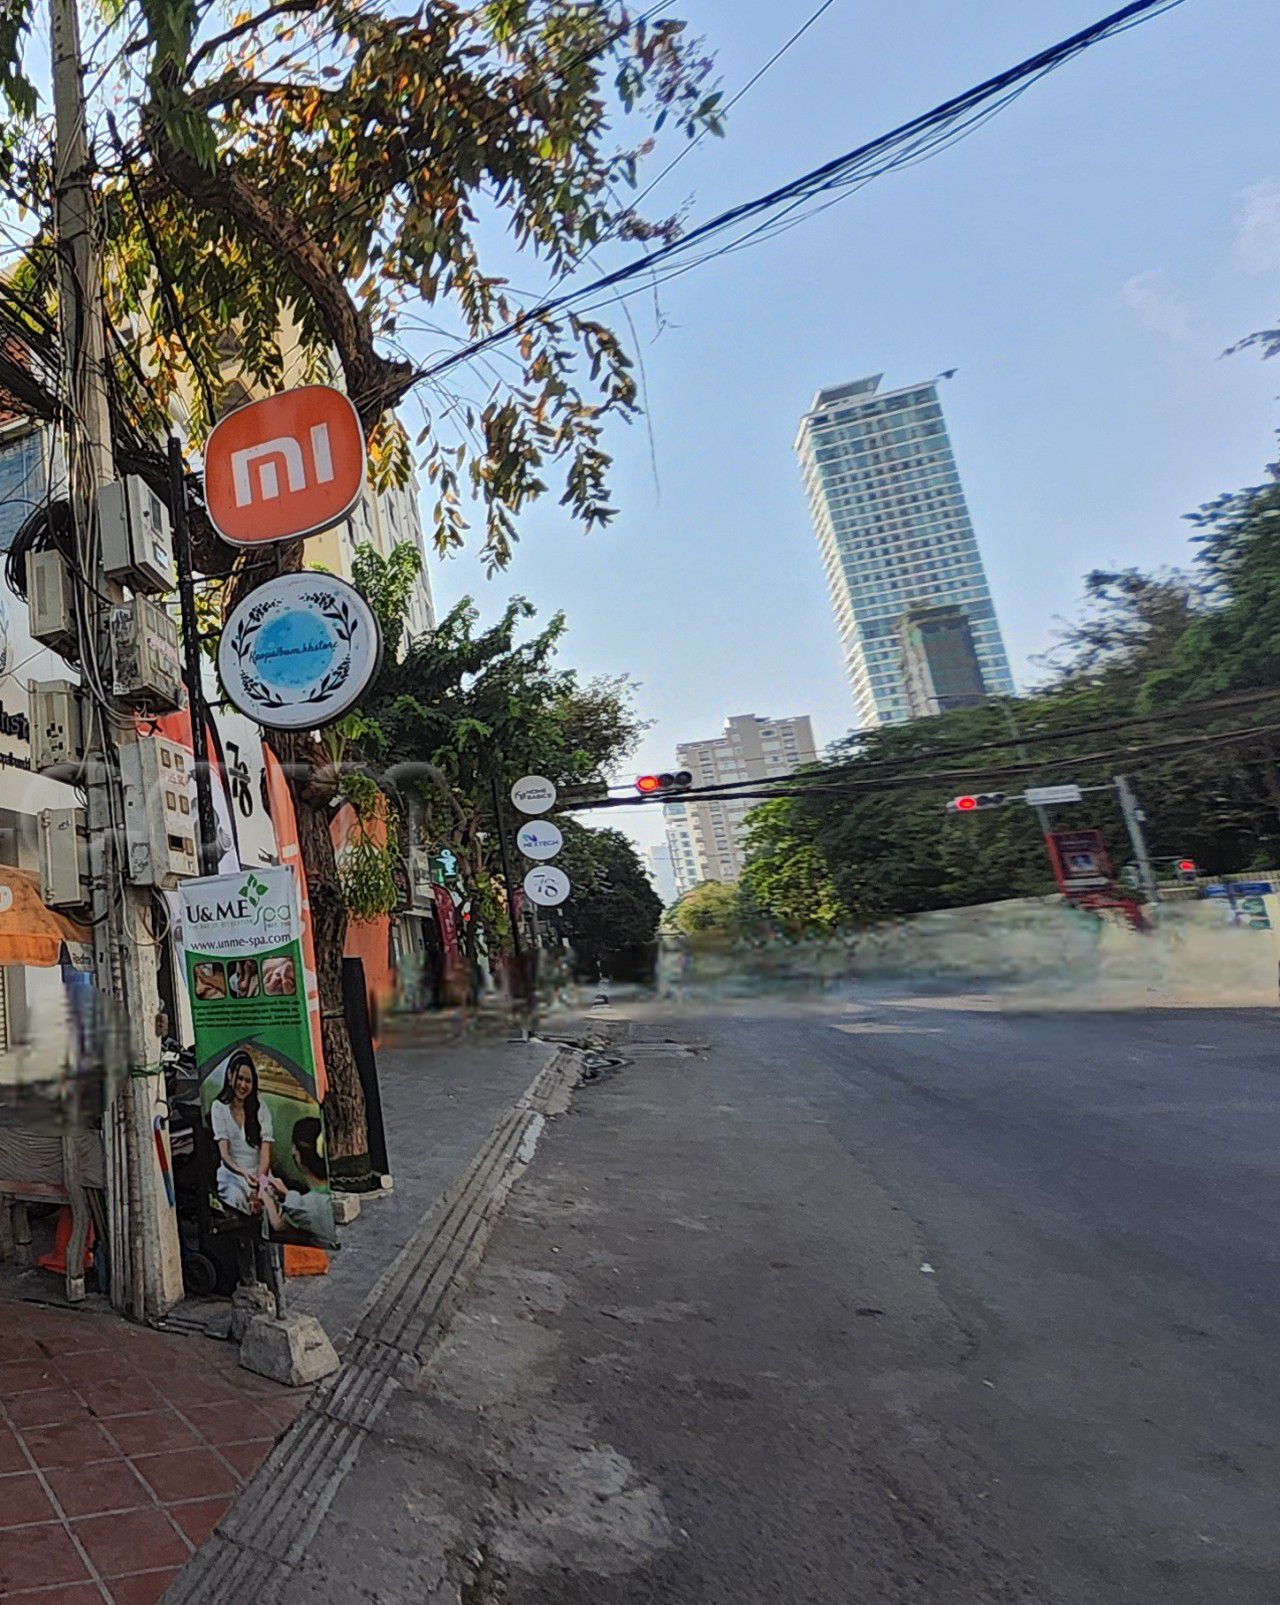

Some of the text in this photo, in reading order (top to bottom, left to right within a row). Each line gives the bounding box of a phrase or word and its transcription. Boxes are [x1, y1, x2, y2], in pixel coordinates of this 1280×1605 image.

[185, 899, 252, 924] U&ME
[252, 905, 292, 932] spa
[189, 933, 292, 951] www.unme-spa.com
